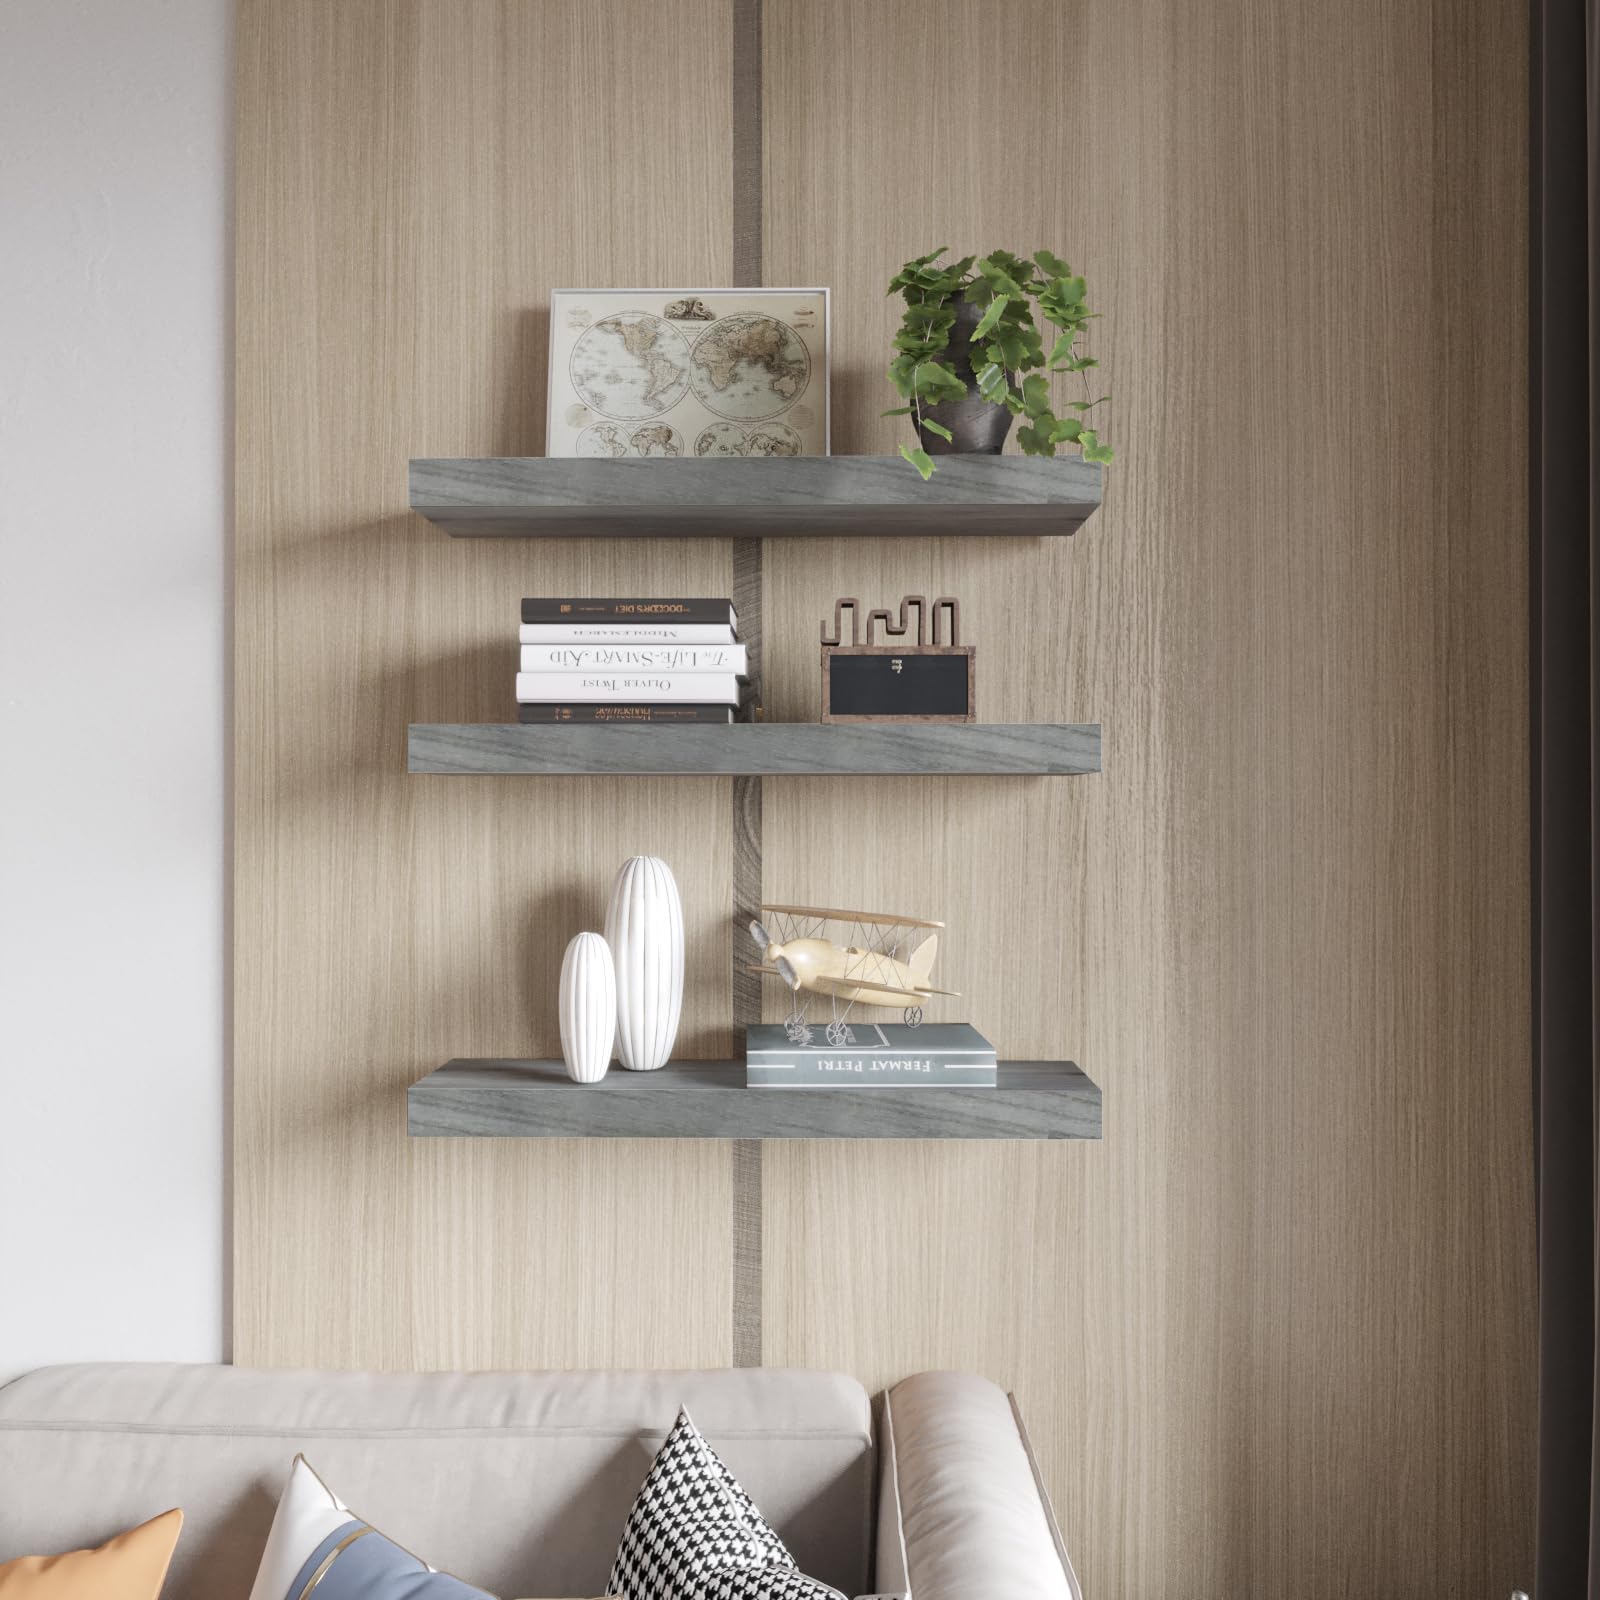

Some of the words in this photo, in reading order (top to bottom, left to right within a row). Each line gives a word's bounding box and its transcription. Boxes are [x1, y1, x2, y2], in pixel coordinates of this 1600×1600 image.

[580, 679, 619, 691] TWIST
[623, 678, 672, 690] OLIVER
[817, 1060, 863, 1073] PETRI
[869, 1060, 931, 1073] FERMAT
